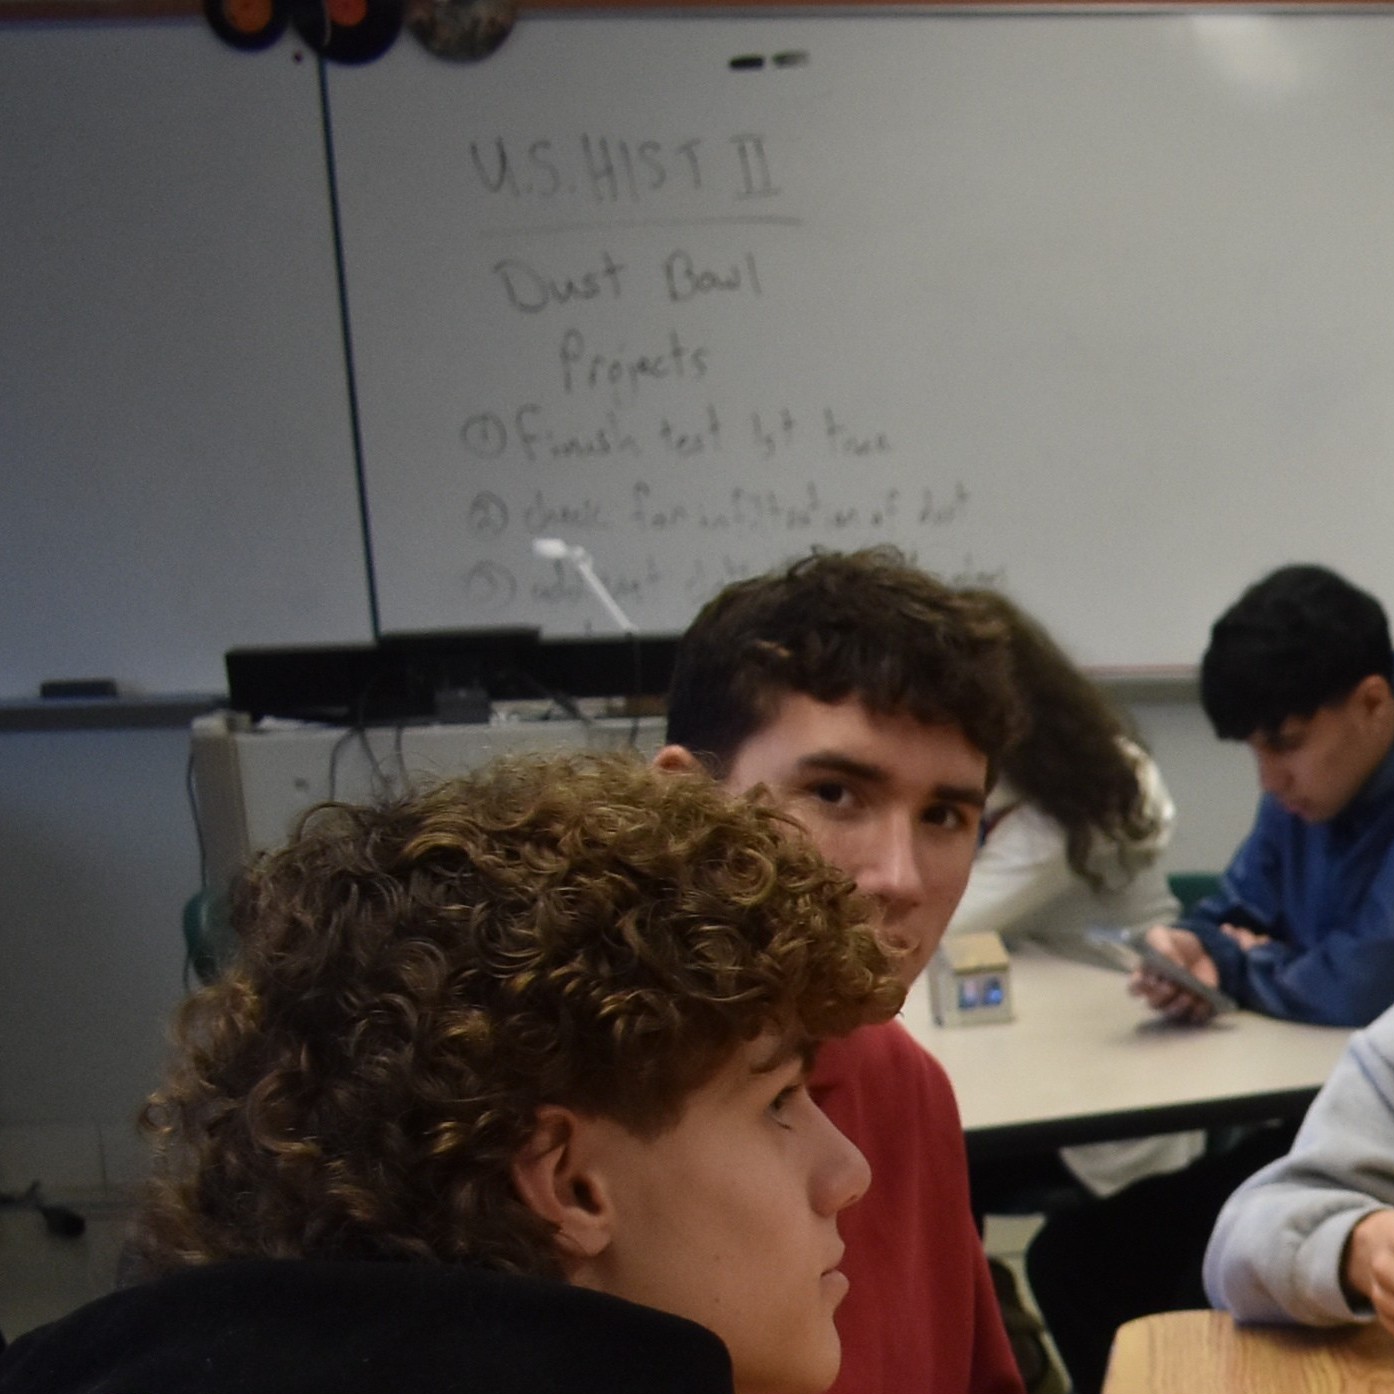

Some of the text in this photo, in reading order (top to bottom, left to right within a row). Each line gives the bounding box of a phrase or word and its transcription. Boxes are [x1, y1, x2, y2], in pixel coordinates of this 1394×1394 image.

[728, 131, 782, 200] II
[493, 247, 763, 316] Dust Bowl
[560, 328, 711, 410] Projects
